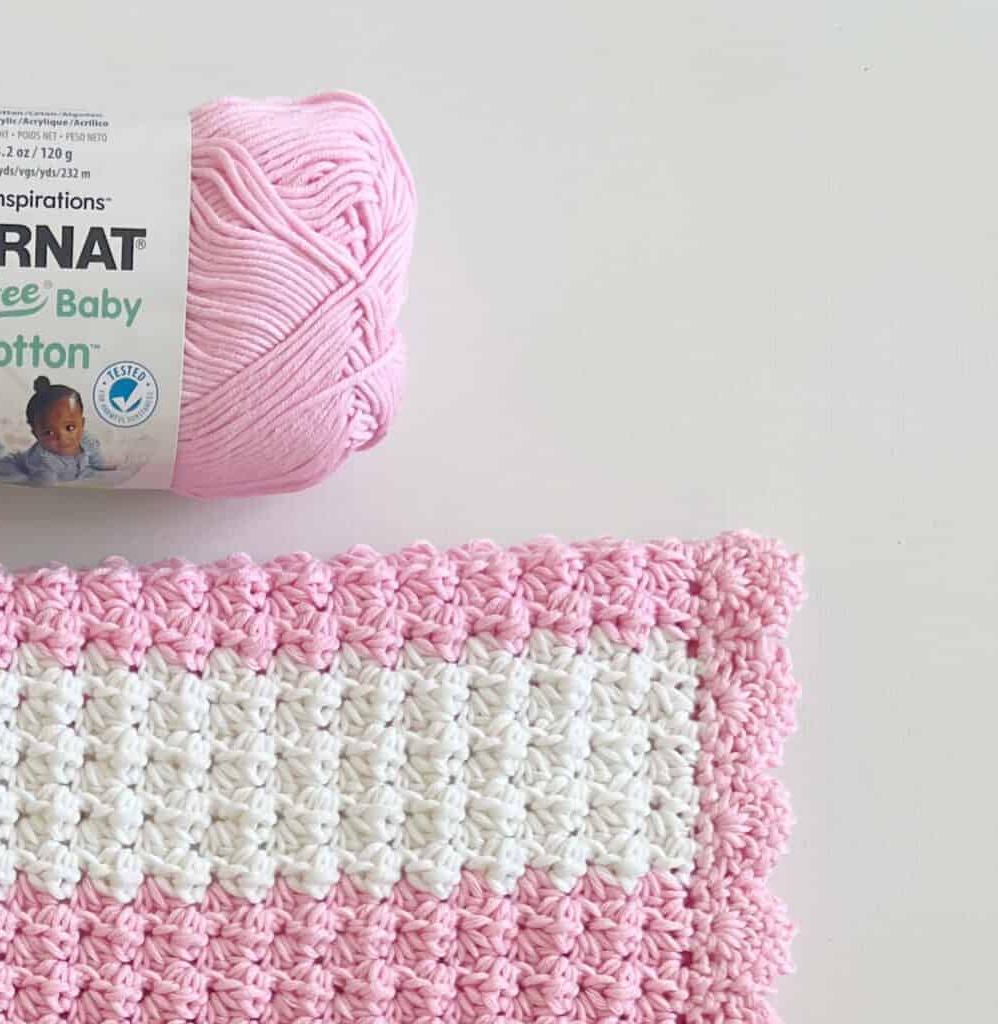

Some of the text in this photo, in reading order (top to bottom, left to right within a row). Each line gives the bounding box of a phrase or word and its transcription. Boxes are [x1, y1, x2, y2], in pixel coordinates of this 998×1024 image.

[17, 131, 41, 141] POIDS
[44, 131, 58, 141] NET
[65, 132, 86, 142] PESO
[87, 132, 108, 143] NETO
[16, 149, 30, 158] oz
[42, 147, 62, 159] 120
[65, 150, 73, 162] g
[81, 170, 91, 179] m
[56, 288, 142, 328] Baby
[106, 365, 146, 381] TESTED
